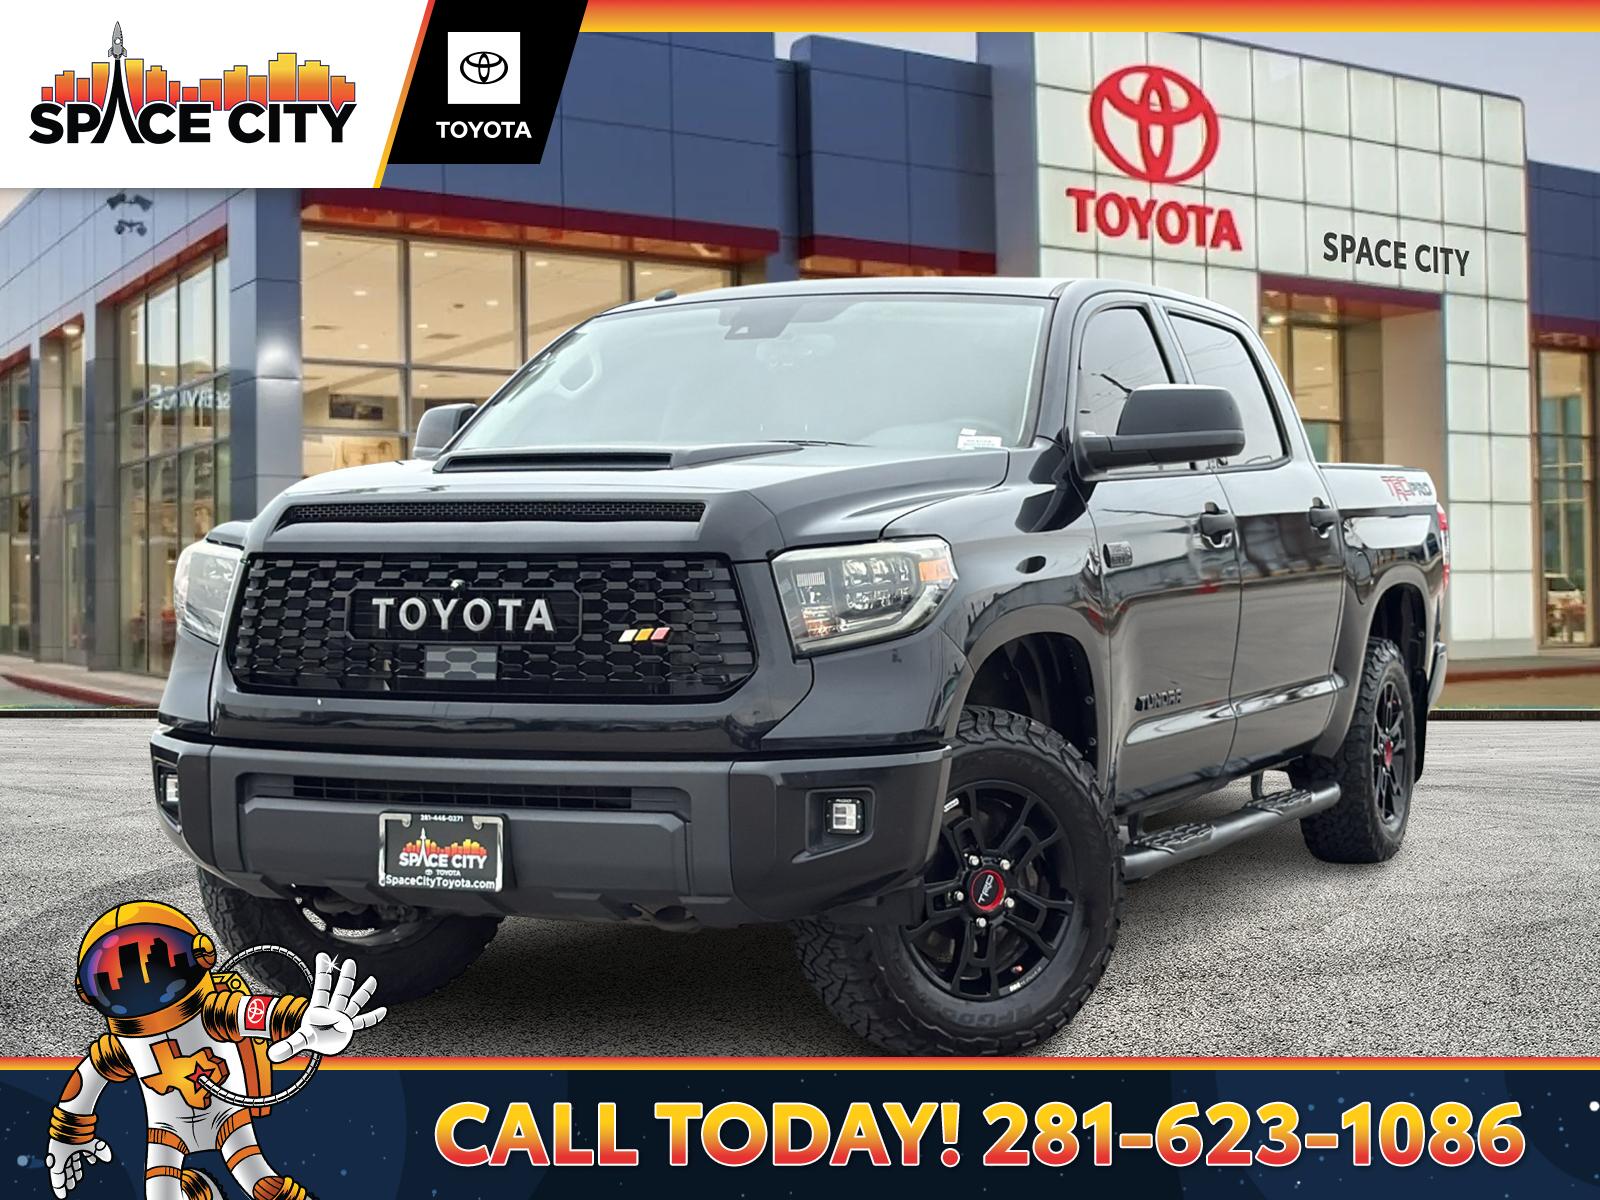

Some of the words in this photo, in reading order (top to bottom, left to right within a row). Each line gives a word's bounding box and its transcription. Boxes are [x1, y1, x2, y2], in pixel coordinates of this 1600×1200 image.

[1065, 187, 1242, 251] TOYOTA
[1322, 231, 1407, 270] SPACE
[1414, 243, 1471, 277] CITY
[372, 597, 556, 632] TOYOTA
[398, 846, 448, 868] SPACE
[451, 854, 488, 869] CITY
[385, 874, 495, 889] SpaceCityToyota.com
[977, 874, 994, 903] TRD
